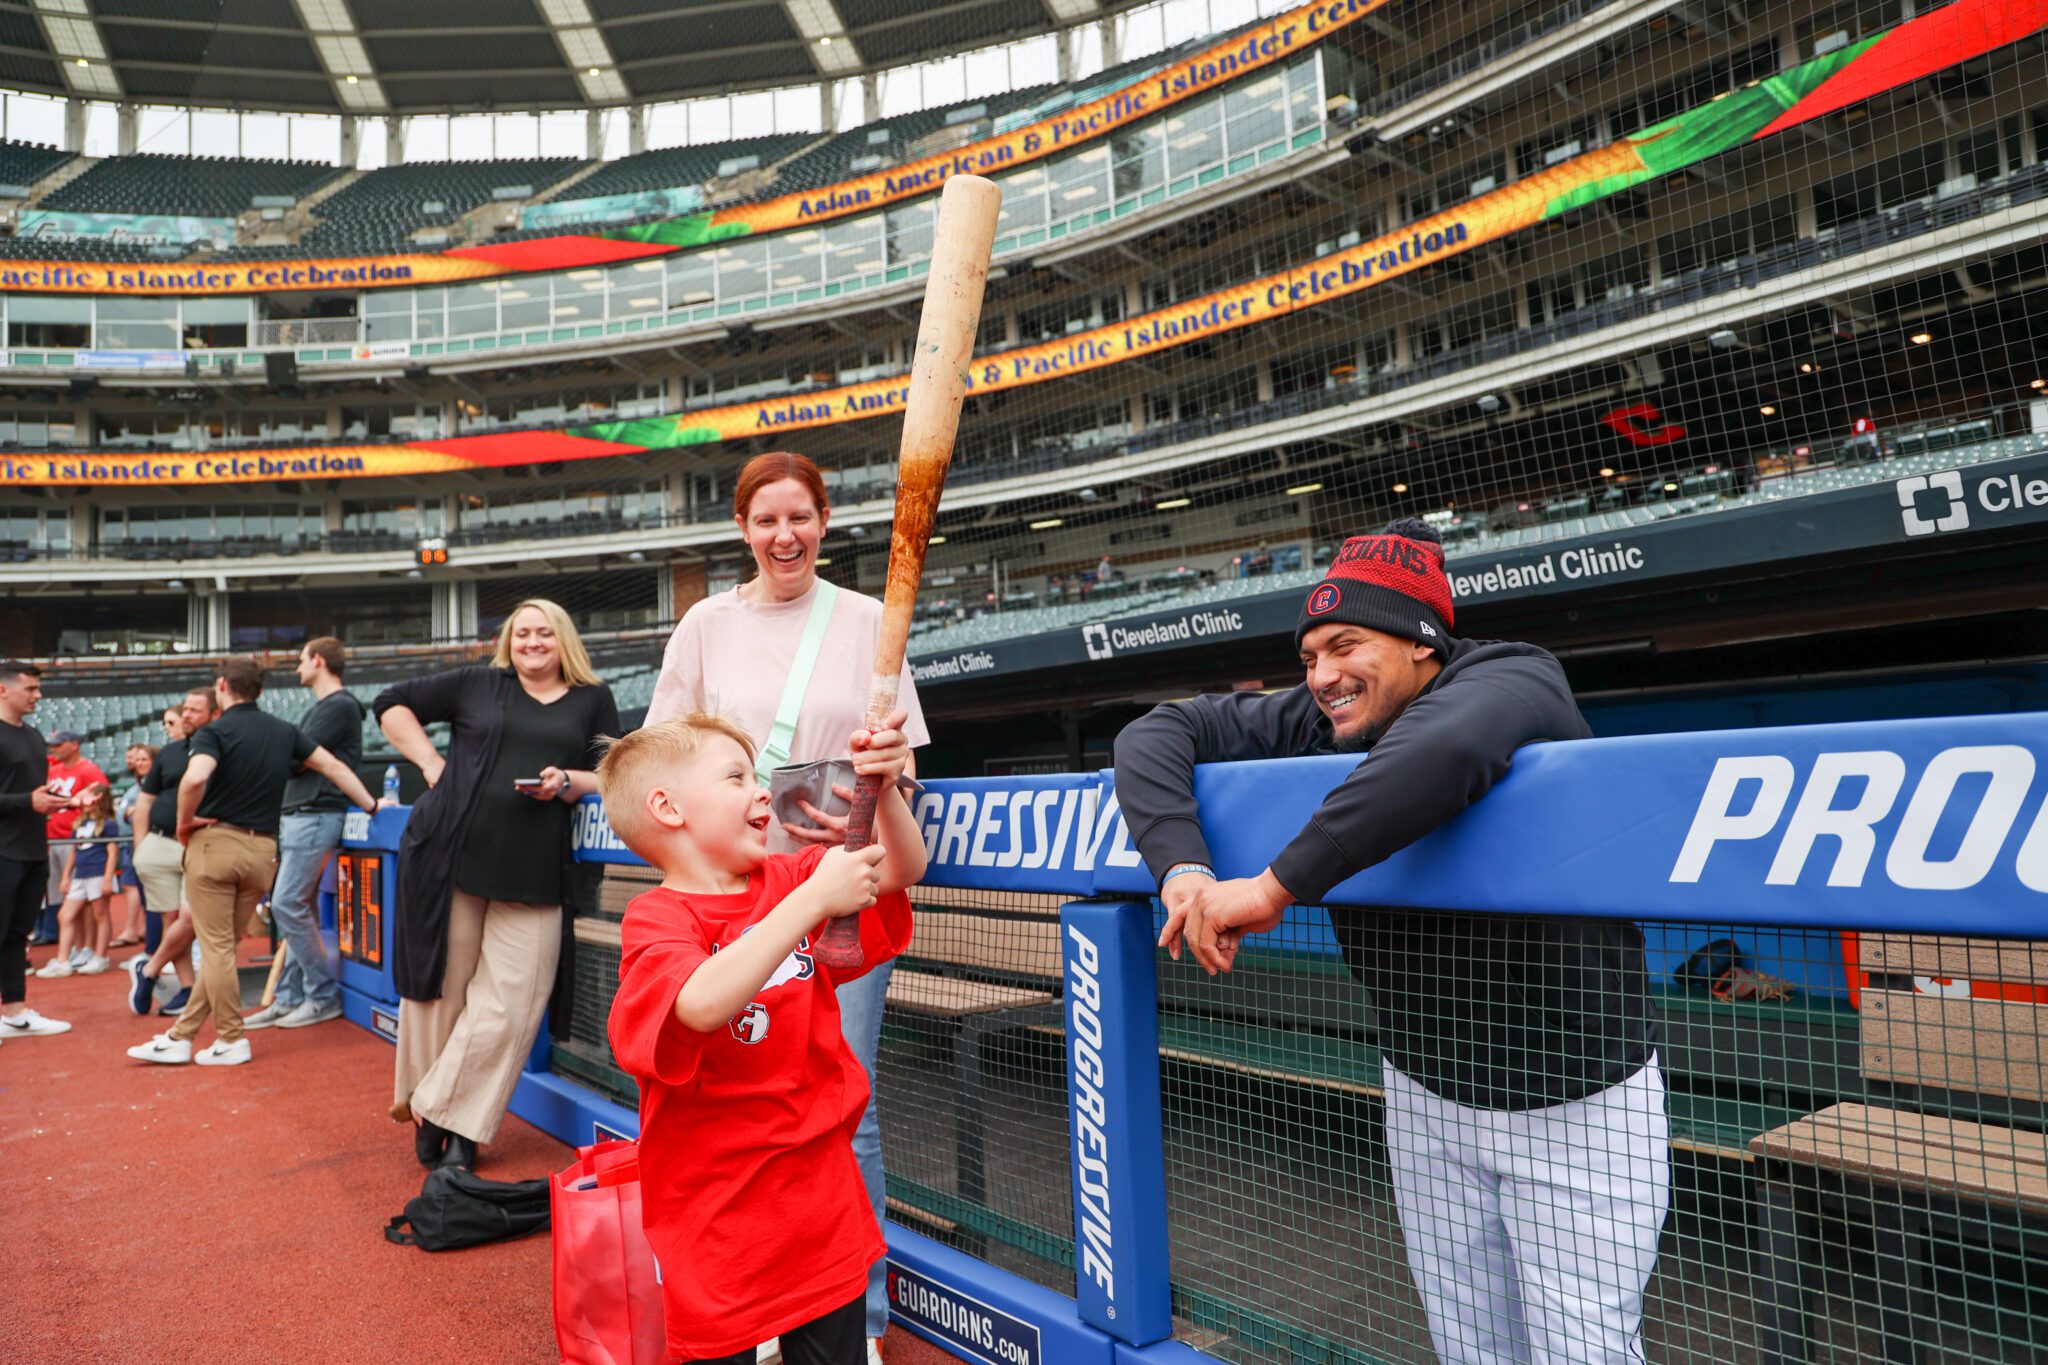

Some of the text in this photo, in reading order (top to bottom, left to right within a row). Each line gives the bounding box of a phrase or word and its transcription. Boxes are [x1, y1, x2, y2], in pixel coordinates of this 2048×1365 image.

[1023, 131, 1042, 152] &
[1051, 91, 1148, 143] Pacific
[1159, 24, 1297, 98] Islander
[105, 269, 238, 288] Islander
[246, 262, 412, 286] Celebration
[983, 363, 1002, 385] &
[1013, 339, 1112, 378] Pacific
[1124, 297, 1256, 350] Islander
[1266, 222, 1467, 308] Celebration
[48, 460, 184, 479] Islander
[195, 454, 364, 478] Celebration
[1448, 542, 1645, 598] leveland Clinic
[1111, 608, 1244, 650] Cleveland Clinic
[959, 651, 996, 673] Clinic
[1668, 744, 2048, 894] PRO
[1068, 923, 1115, 1303] PROGRESSIVE
